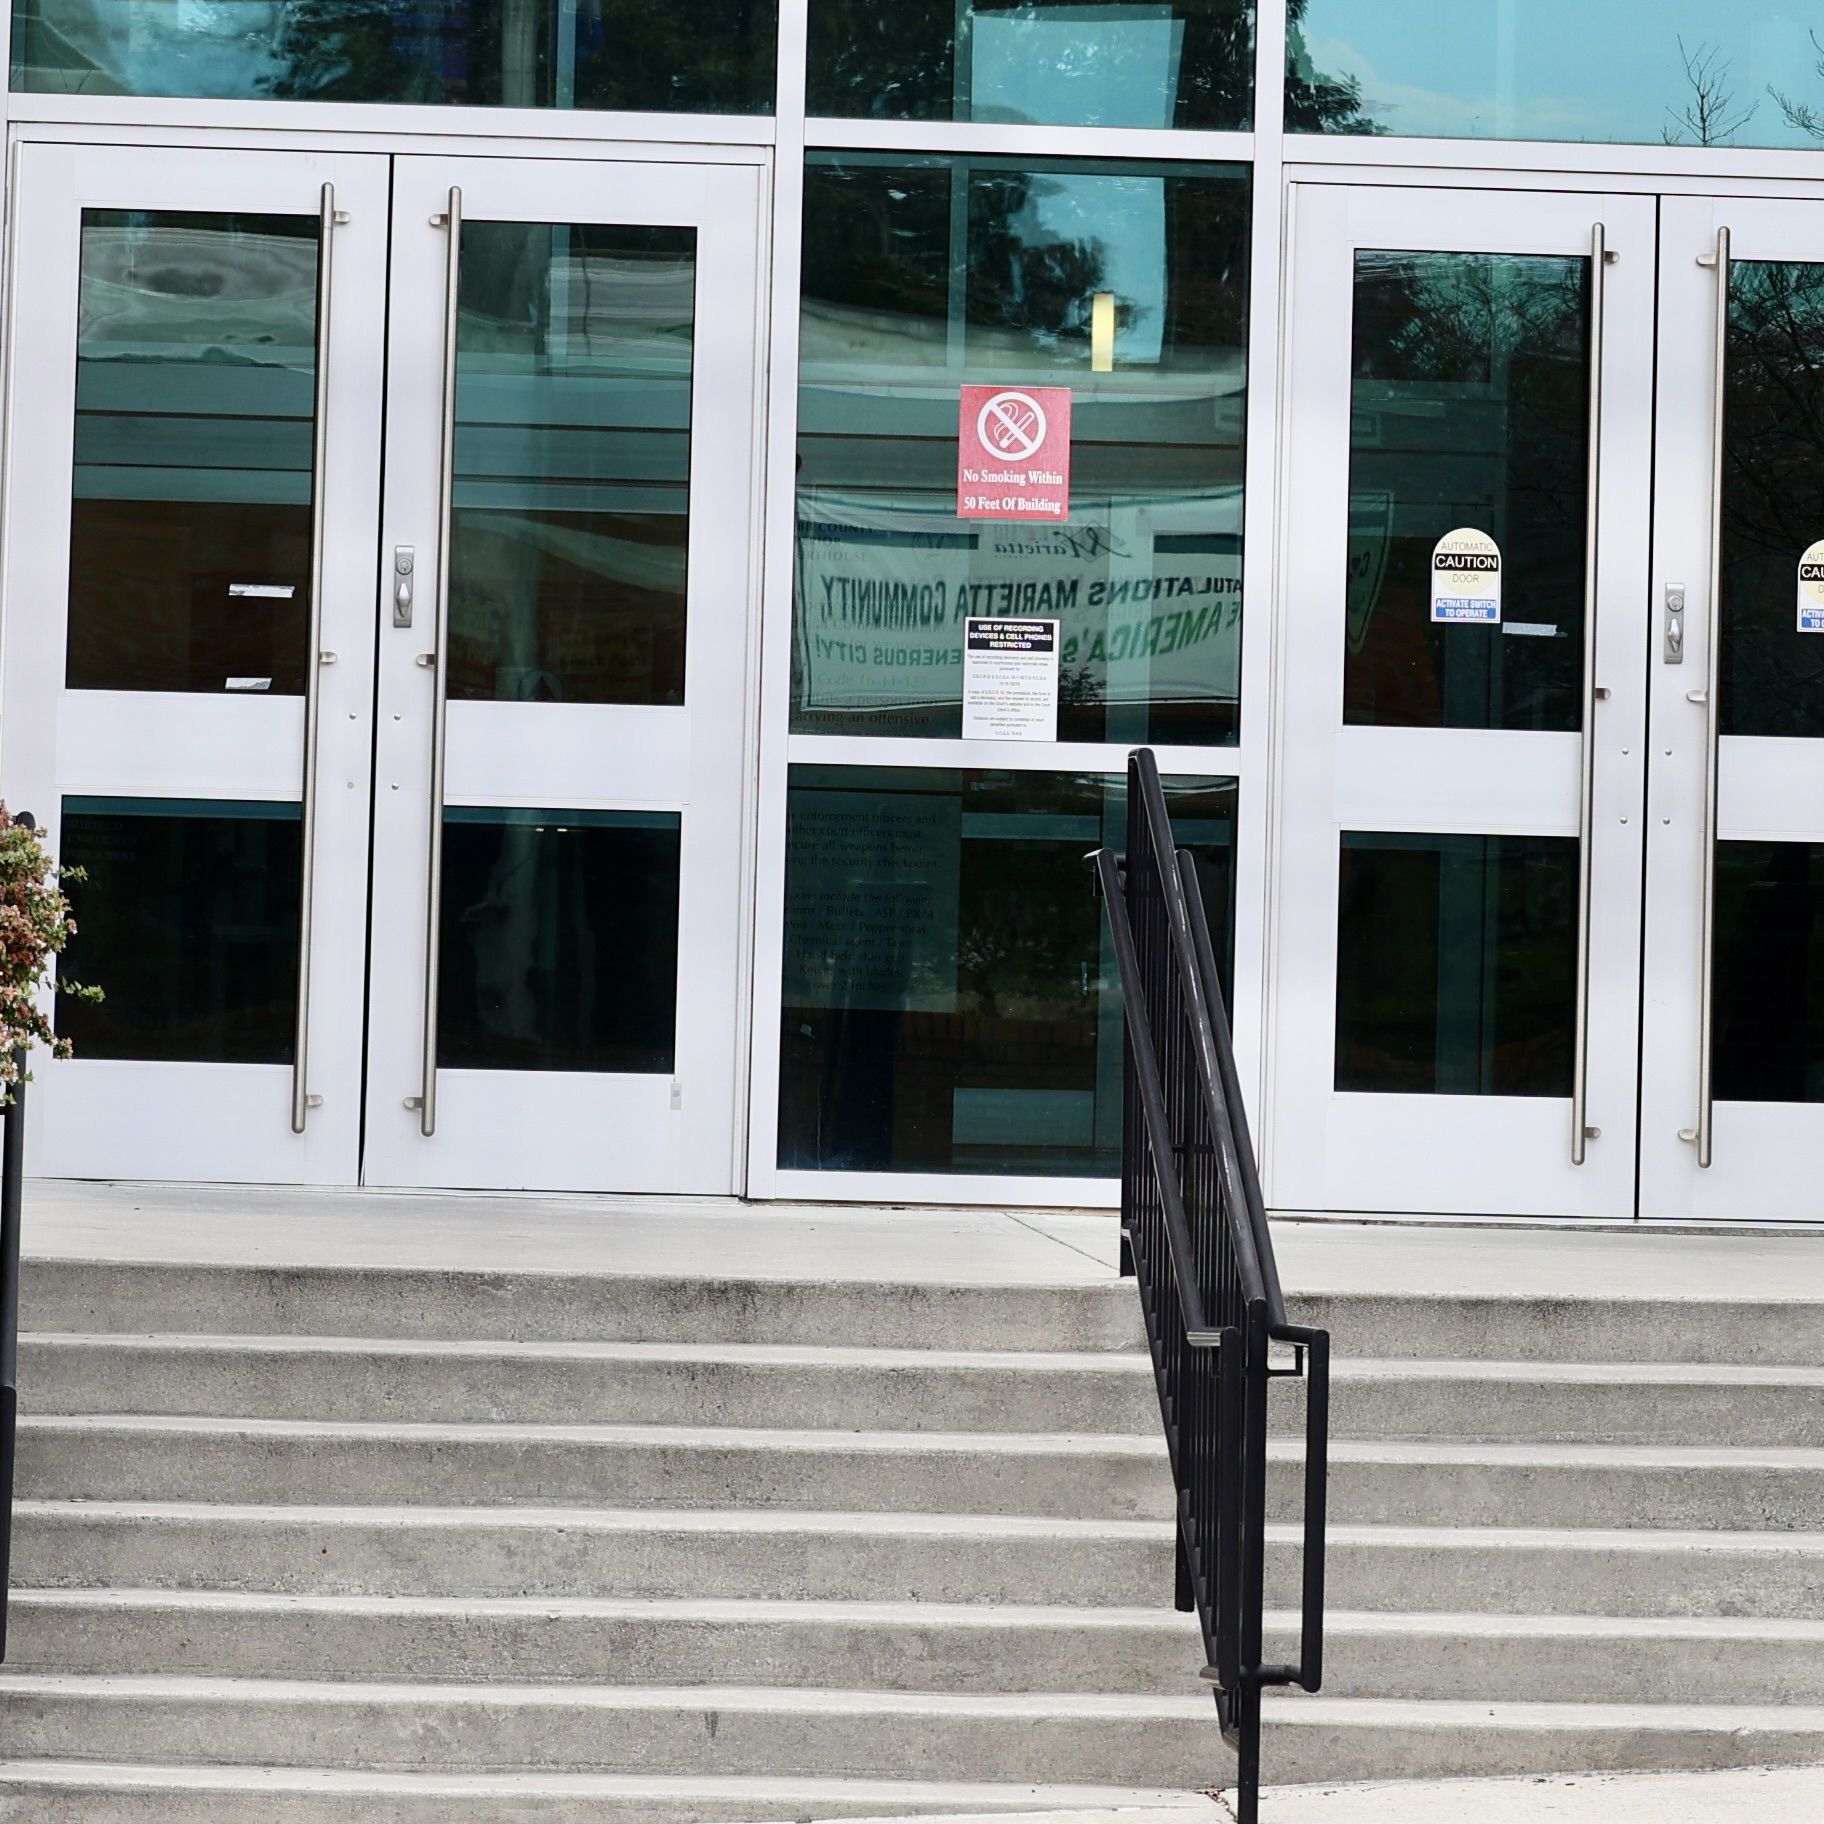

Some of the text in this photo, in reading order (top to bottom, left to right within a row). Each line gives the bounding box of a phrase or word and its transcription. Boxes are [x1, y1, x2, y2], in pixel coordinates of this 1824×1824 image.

[963, 468, 1063, 486] No Smoking Within
[963, 496, 1061, 514] 50 Feet Of Building
[1441, 541, 1493, 552] AUTOMATIC
[1436, 555, 1497, 568] CAUTION
[1452, 574, 1480, 583] DOOR
[1436, 599, 1496, 609] ACTIVATE SWITCH
[1445, 609, 1488, 618] TO OPERATE
[1811, 619, 1820, 628] TO
[1024, 633, 1052, 641] PHONES
[989, 641, 1032, 649] RESTRICTED
